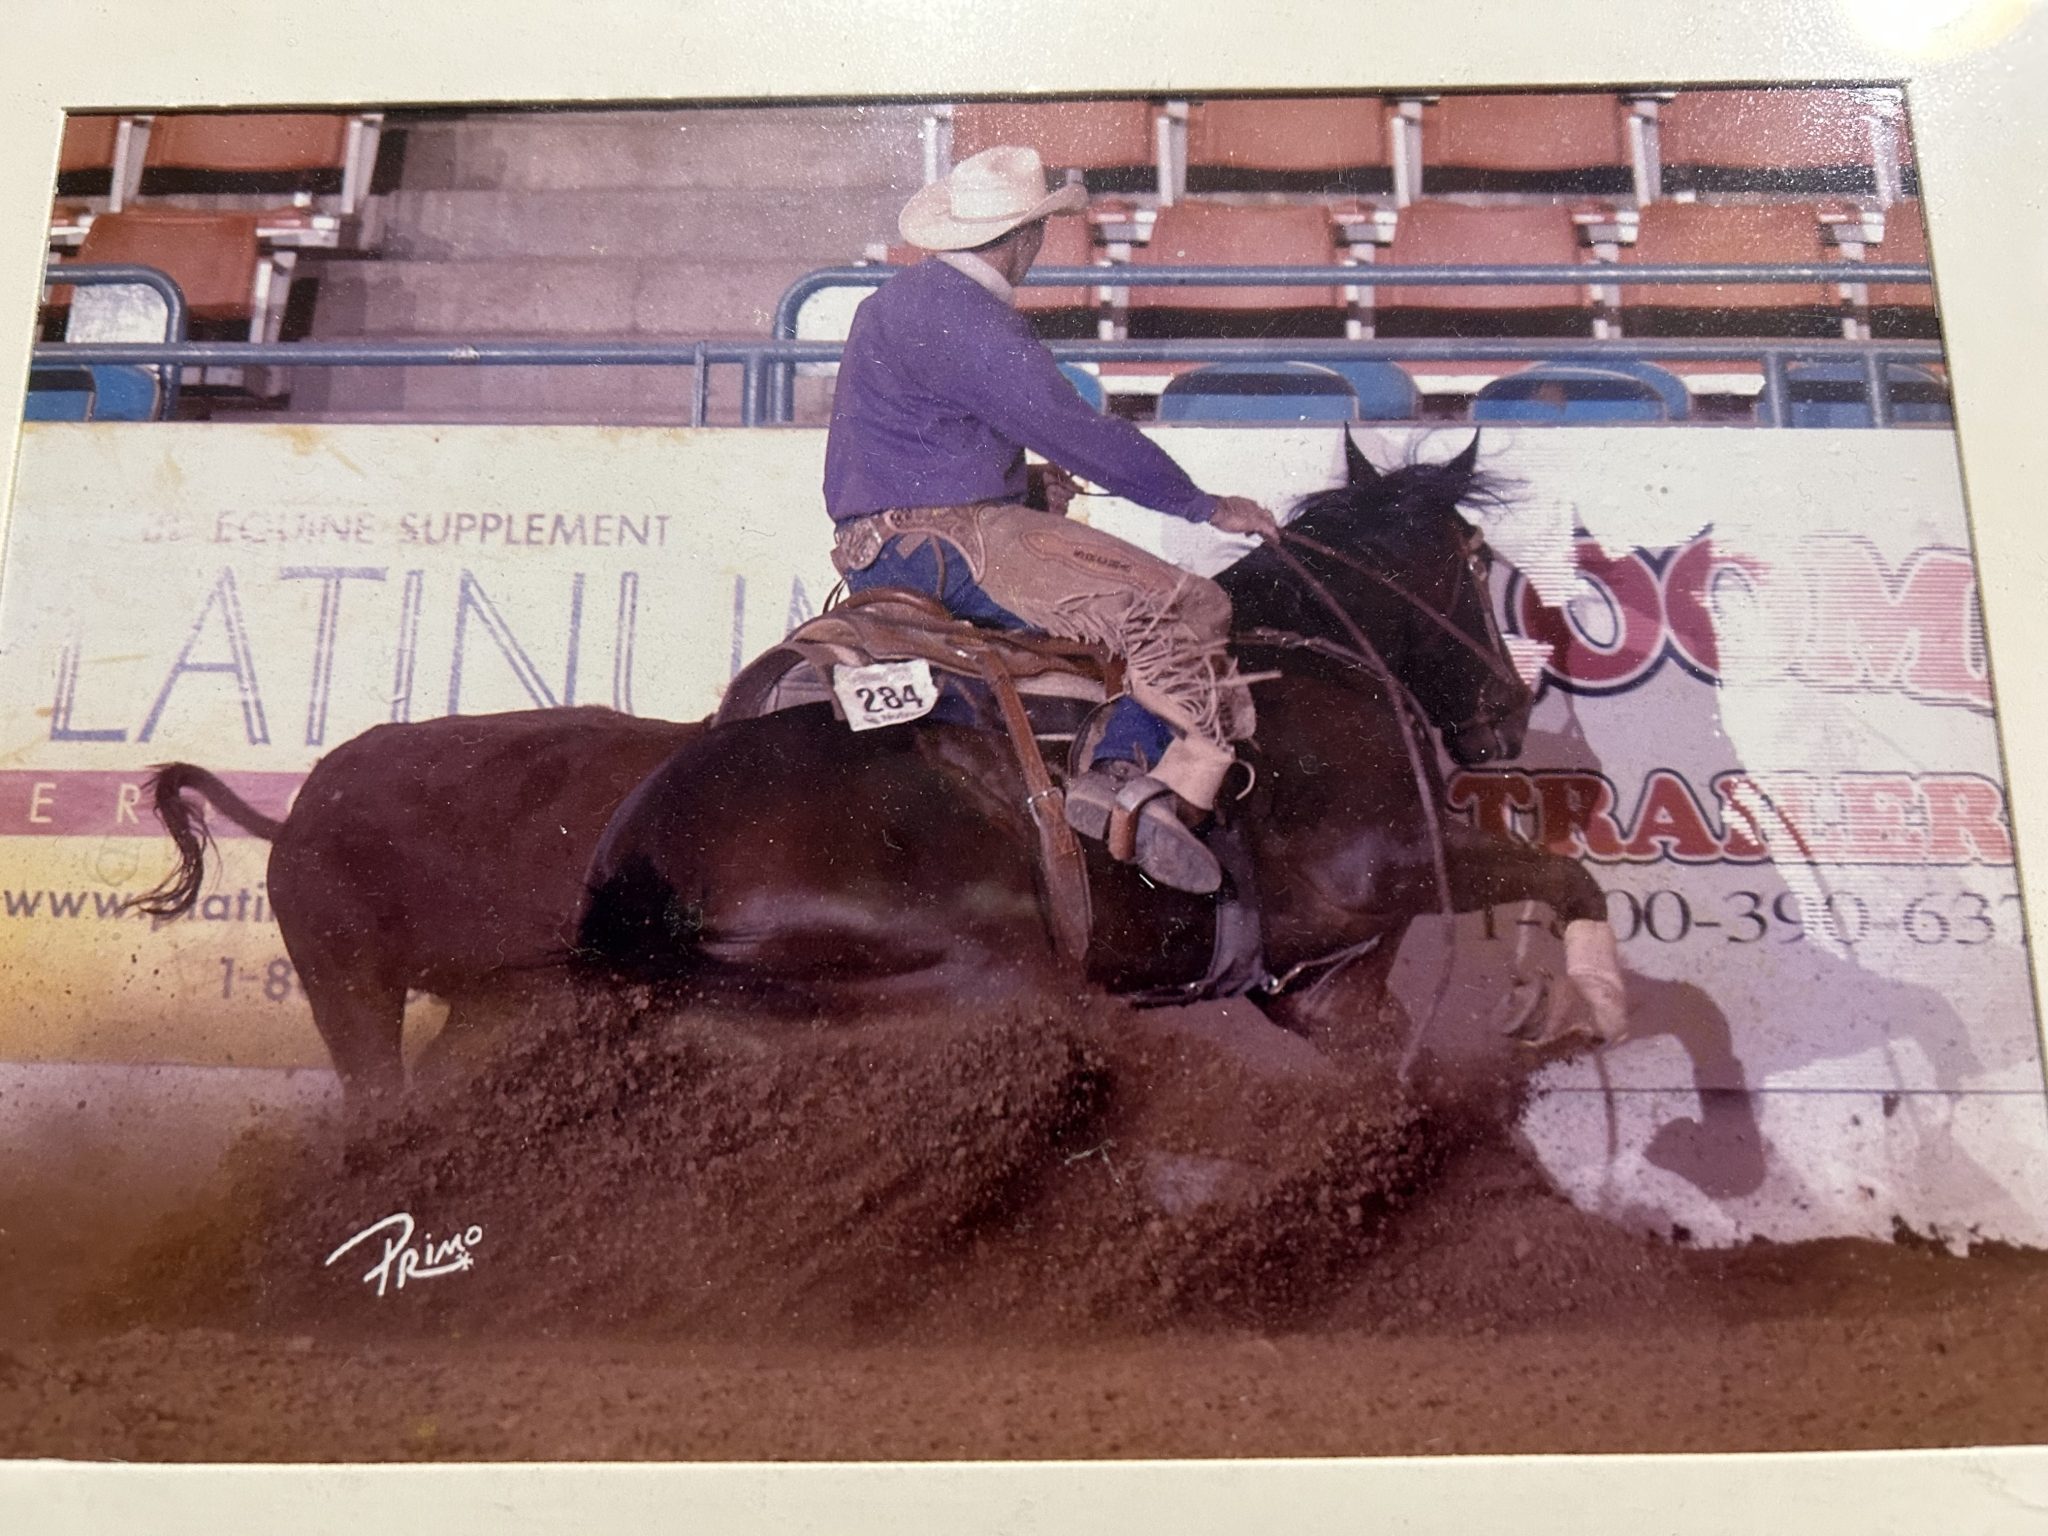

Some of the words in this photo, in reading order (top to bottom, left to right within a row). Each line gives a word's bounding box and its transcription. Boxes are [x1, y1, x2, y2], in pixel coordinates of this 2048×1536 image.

[399, 512, 670, 546] SUPPLEMENT
[50, 564, 814, 746] LATINU
[855, 683, 924, 714] 284
[1445, 767, 2016, 868] TRAILER
